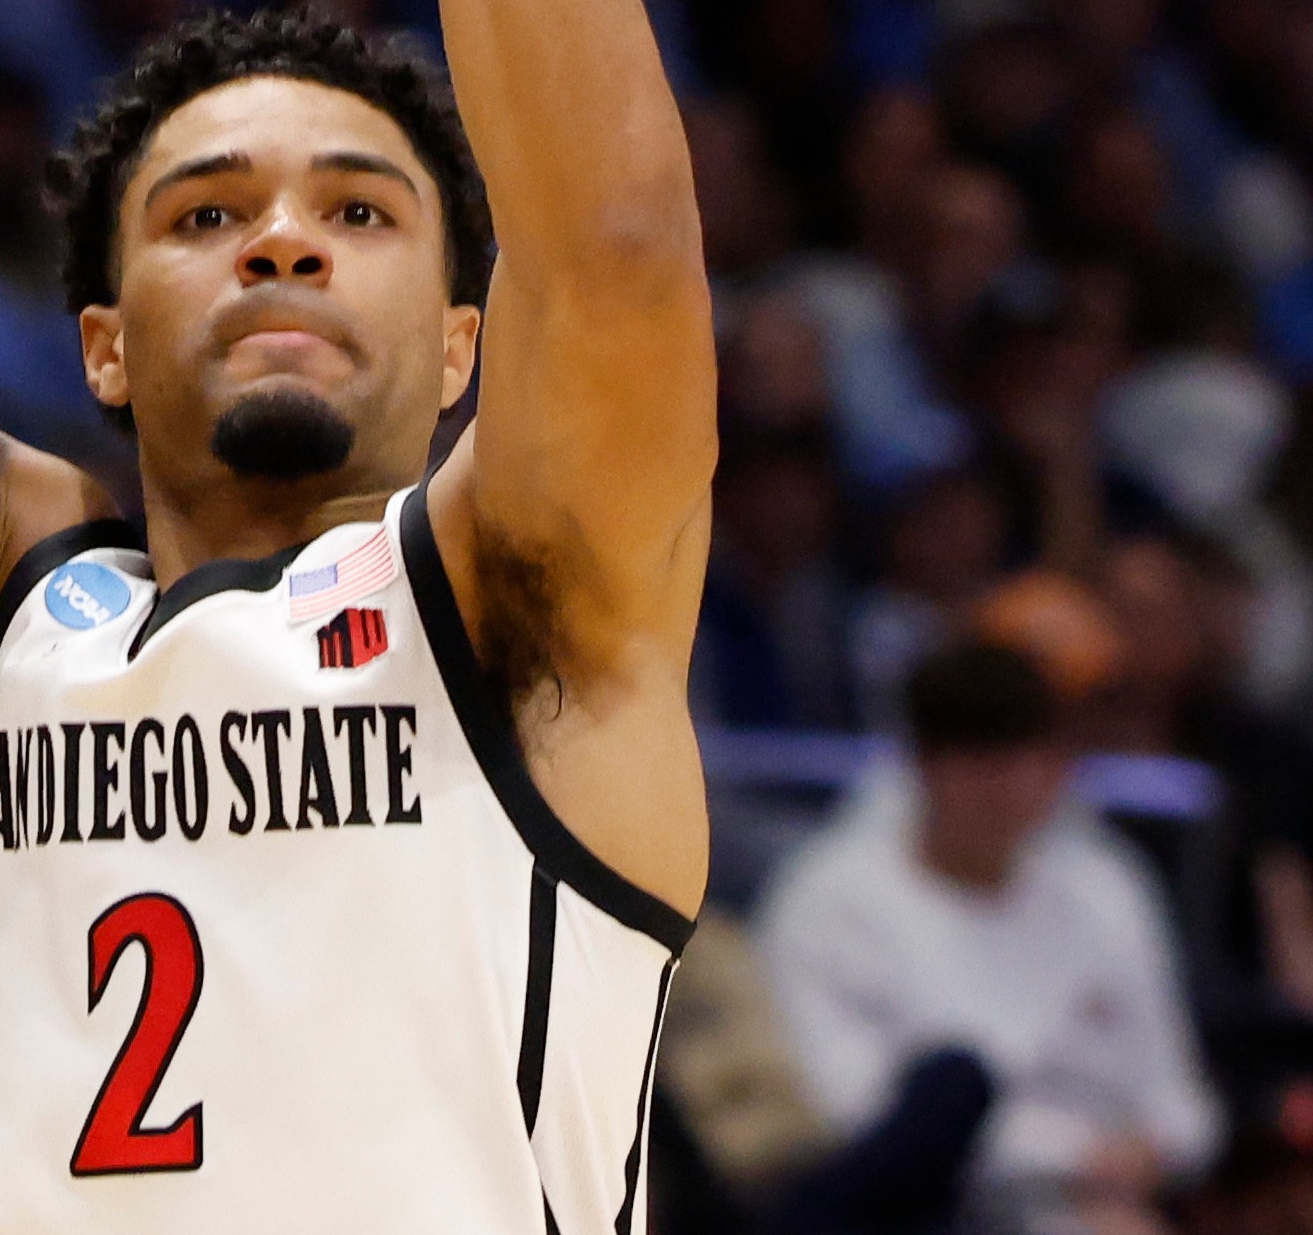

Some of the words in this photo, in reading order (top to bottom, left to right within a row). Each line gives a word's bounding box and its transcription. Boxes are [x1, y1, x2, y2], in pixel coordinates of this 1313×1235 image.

[36, 713, 209, 846] DIEGO
[219, 704, 423, 836] STATE
[70, 891, 204, 1178] 2
